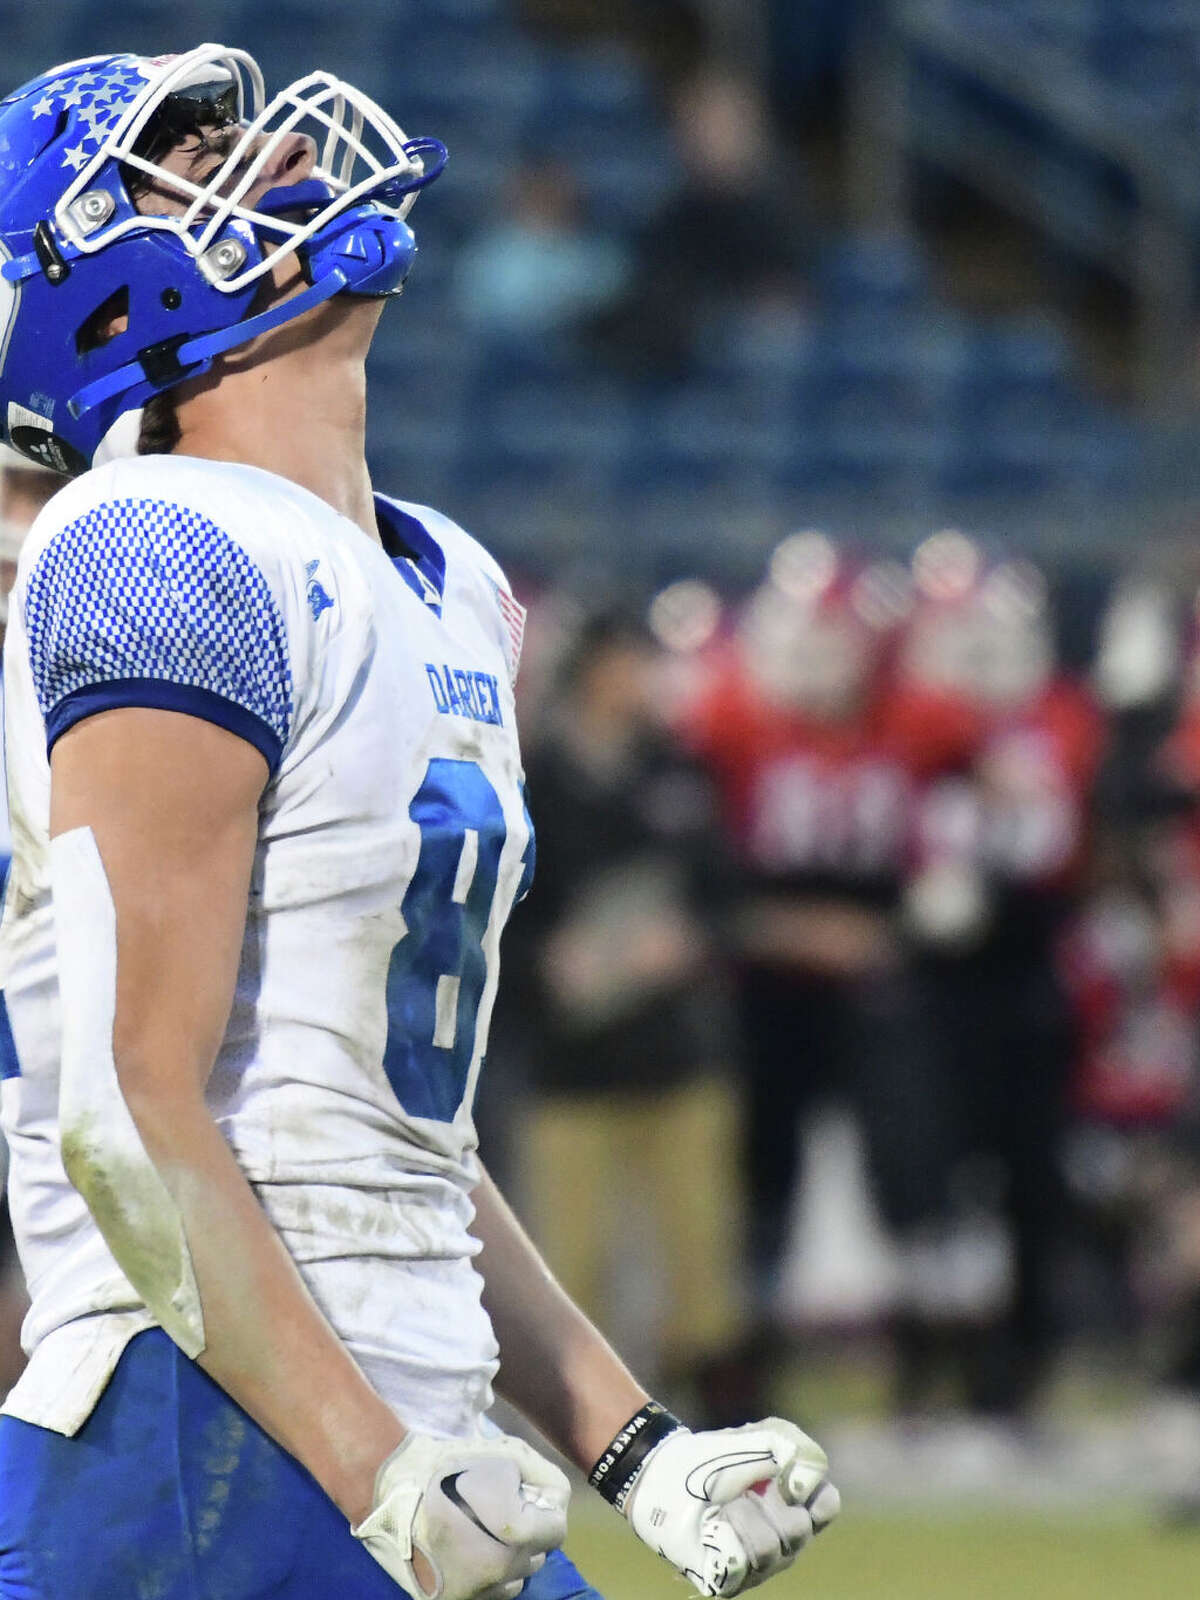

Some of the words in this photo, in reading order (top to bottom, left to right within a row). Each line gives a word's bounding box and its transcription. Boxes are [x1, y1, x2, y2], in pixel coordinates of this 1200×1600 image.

[424, 663, 503, 728] DARIEN
[383, 757, 536, 1123] 8
[612, 1416, 648, 1454] WAKE
